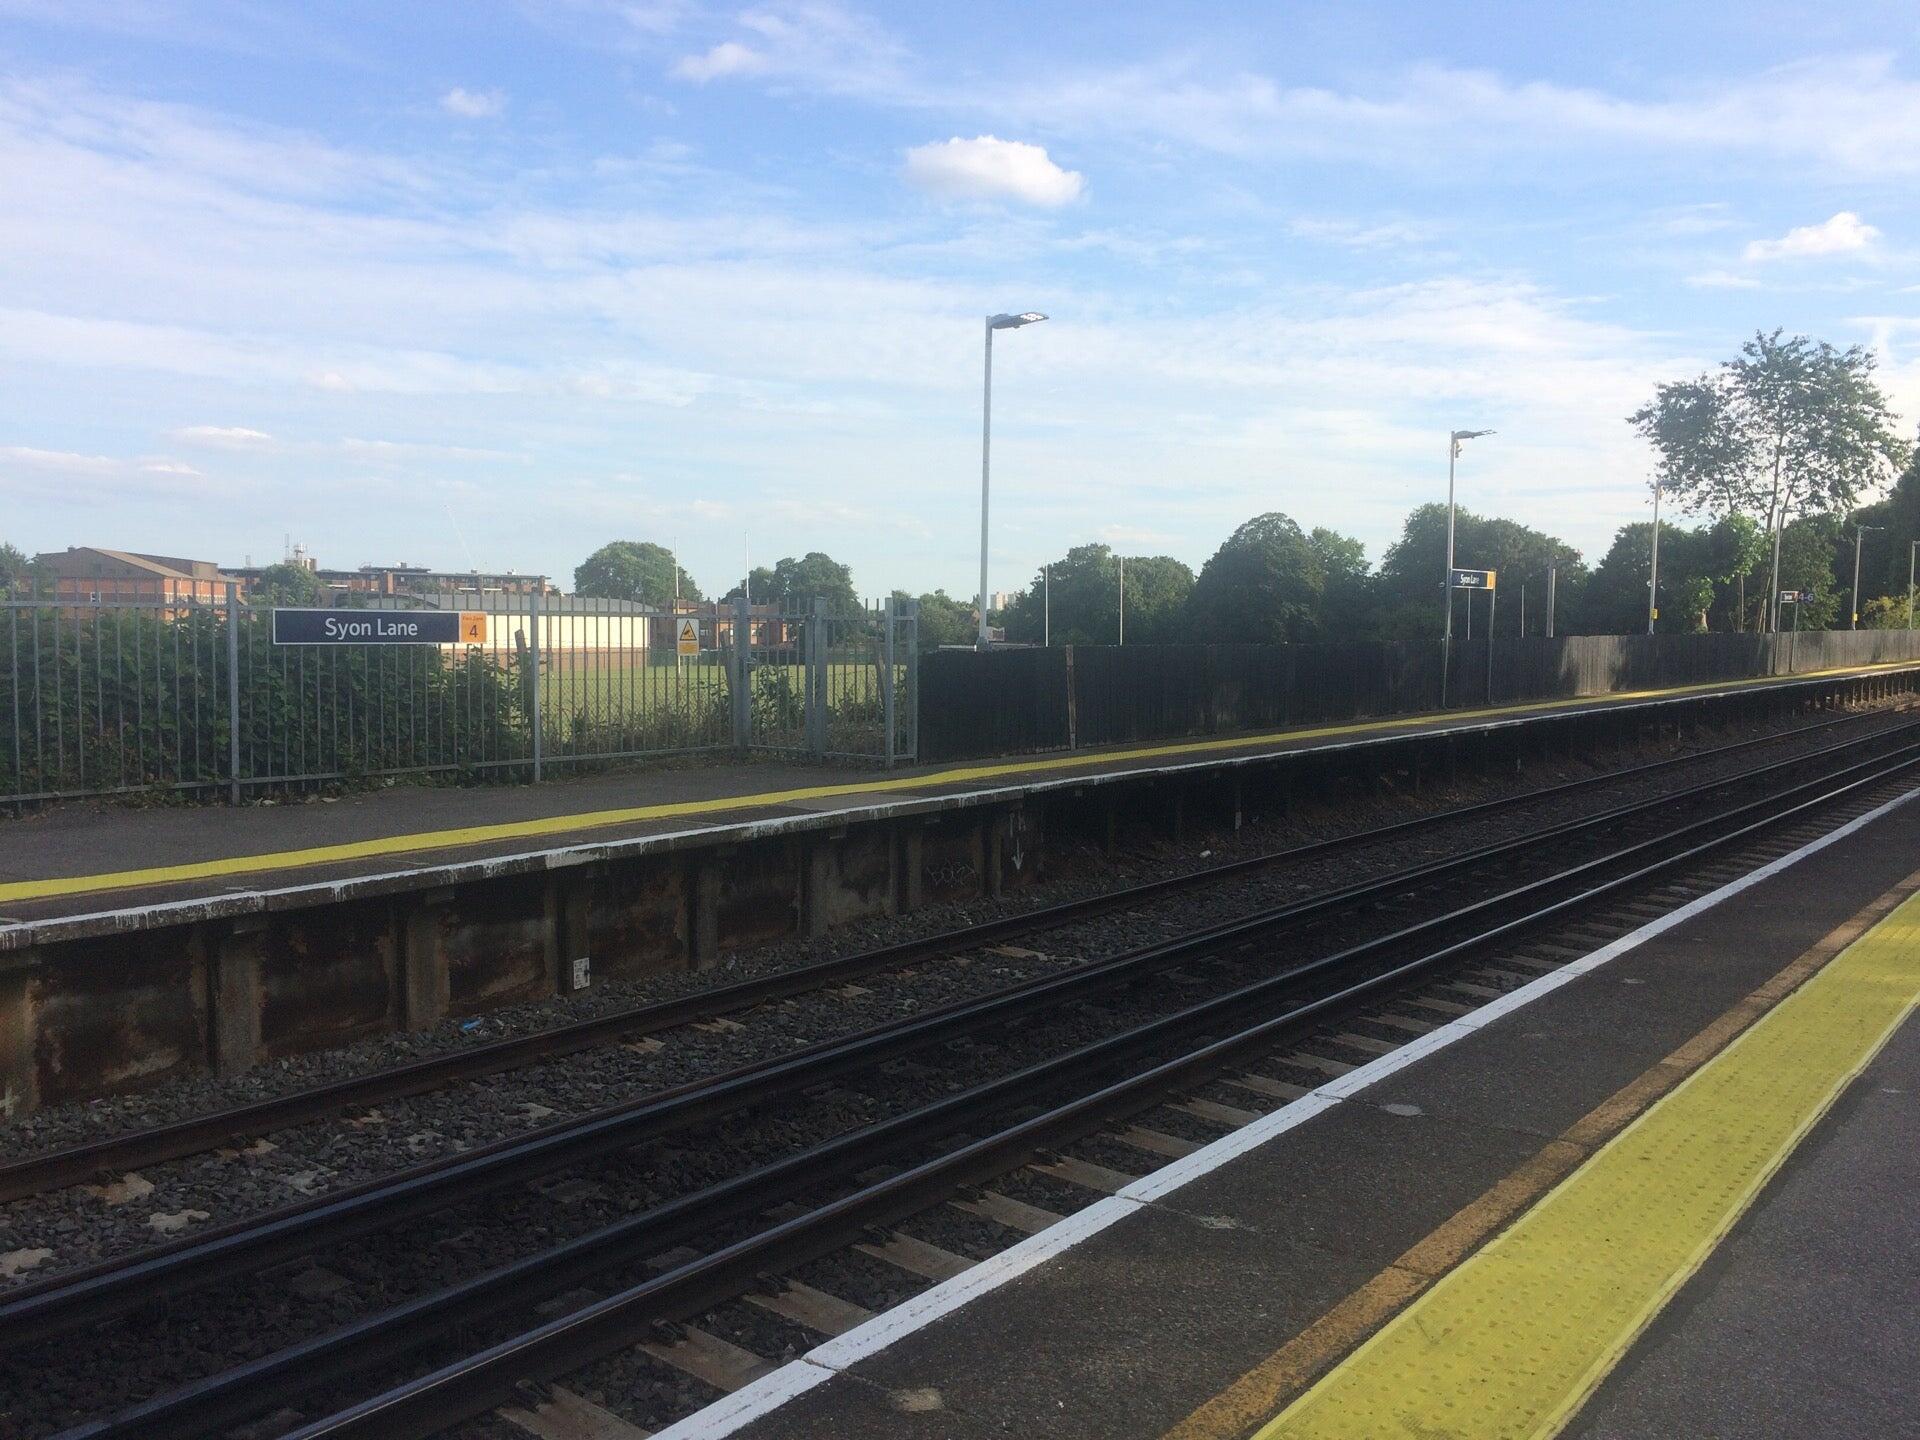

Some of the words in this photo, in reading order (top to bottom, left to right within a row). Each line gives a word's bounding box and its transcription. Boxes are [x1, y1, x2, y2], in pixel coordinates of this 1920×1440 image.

[1460, 573, 1470, 585] Syon
[325, 617, 371, 640] Syon
[377, 618, 418, 636] Lane
[469, 624, 479, 638] 4
